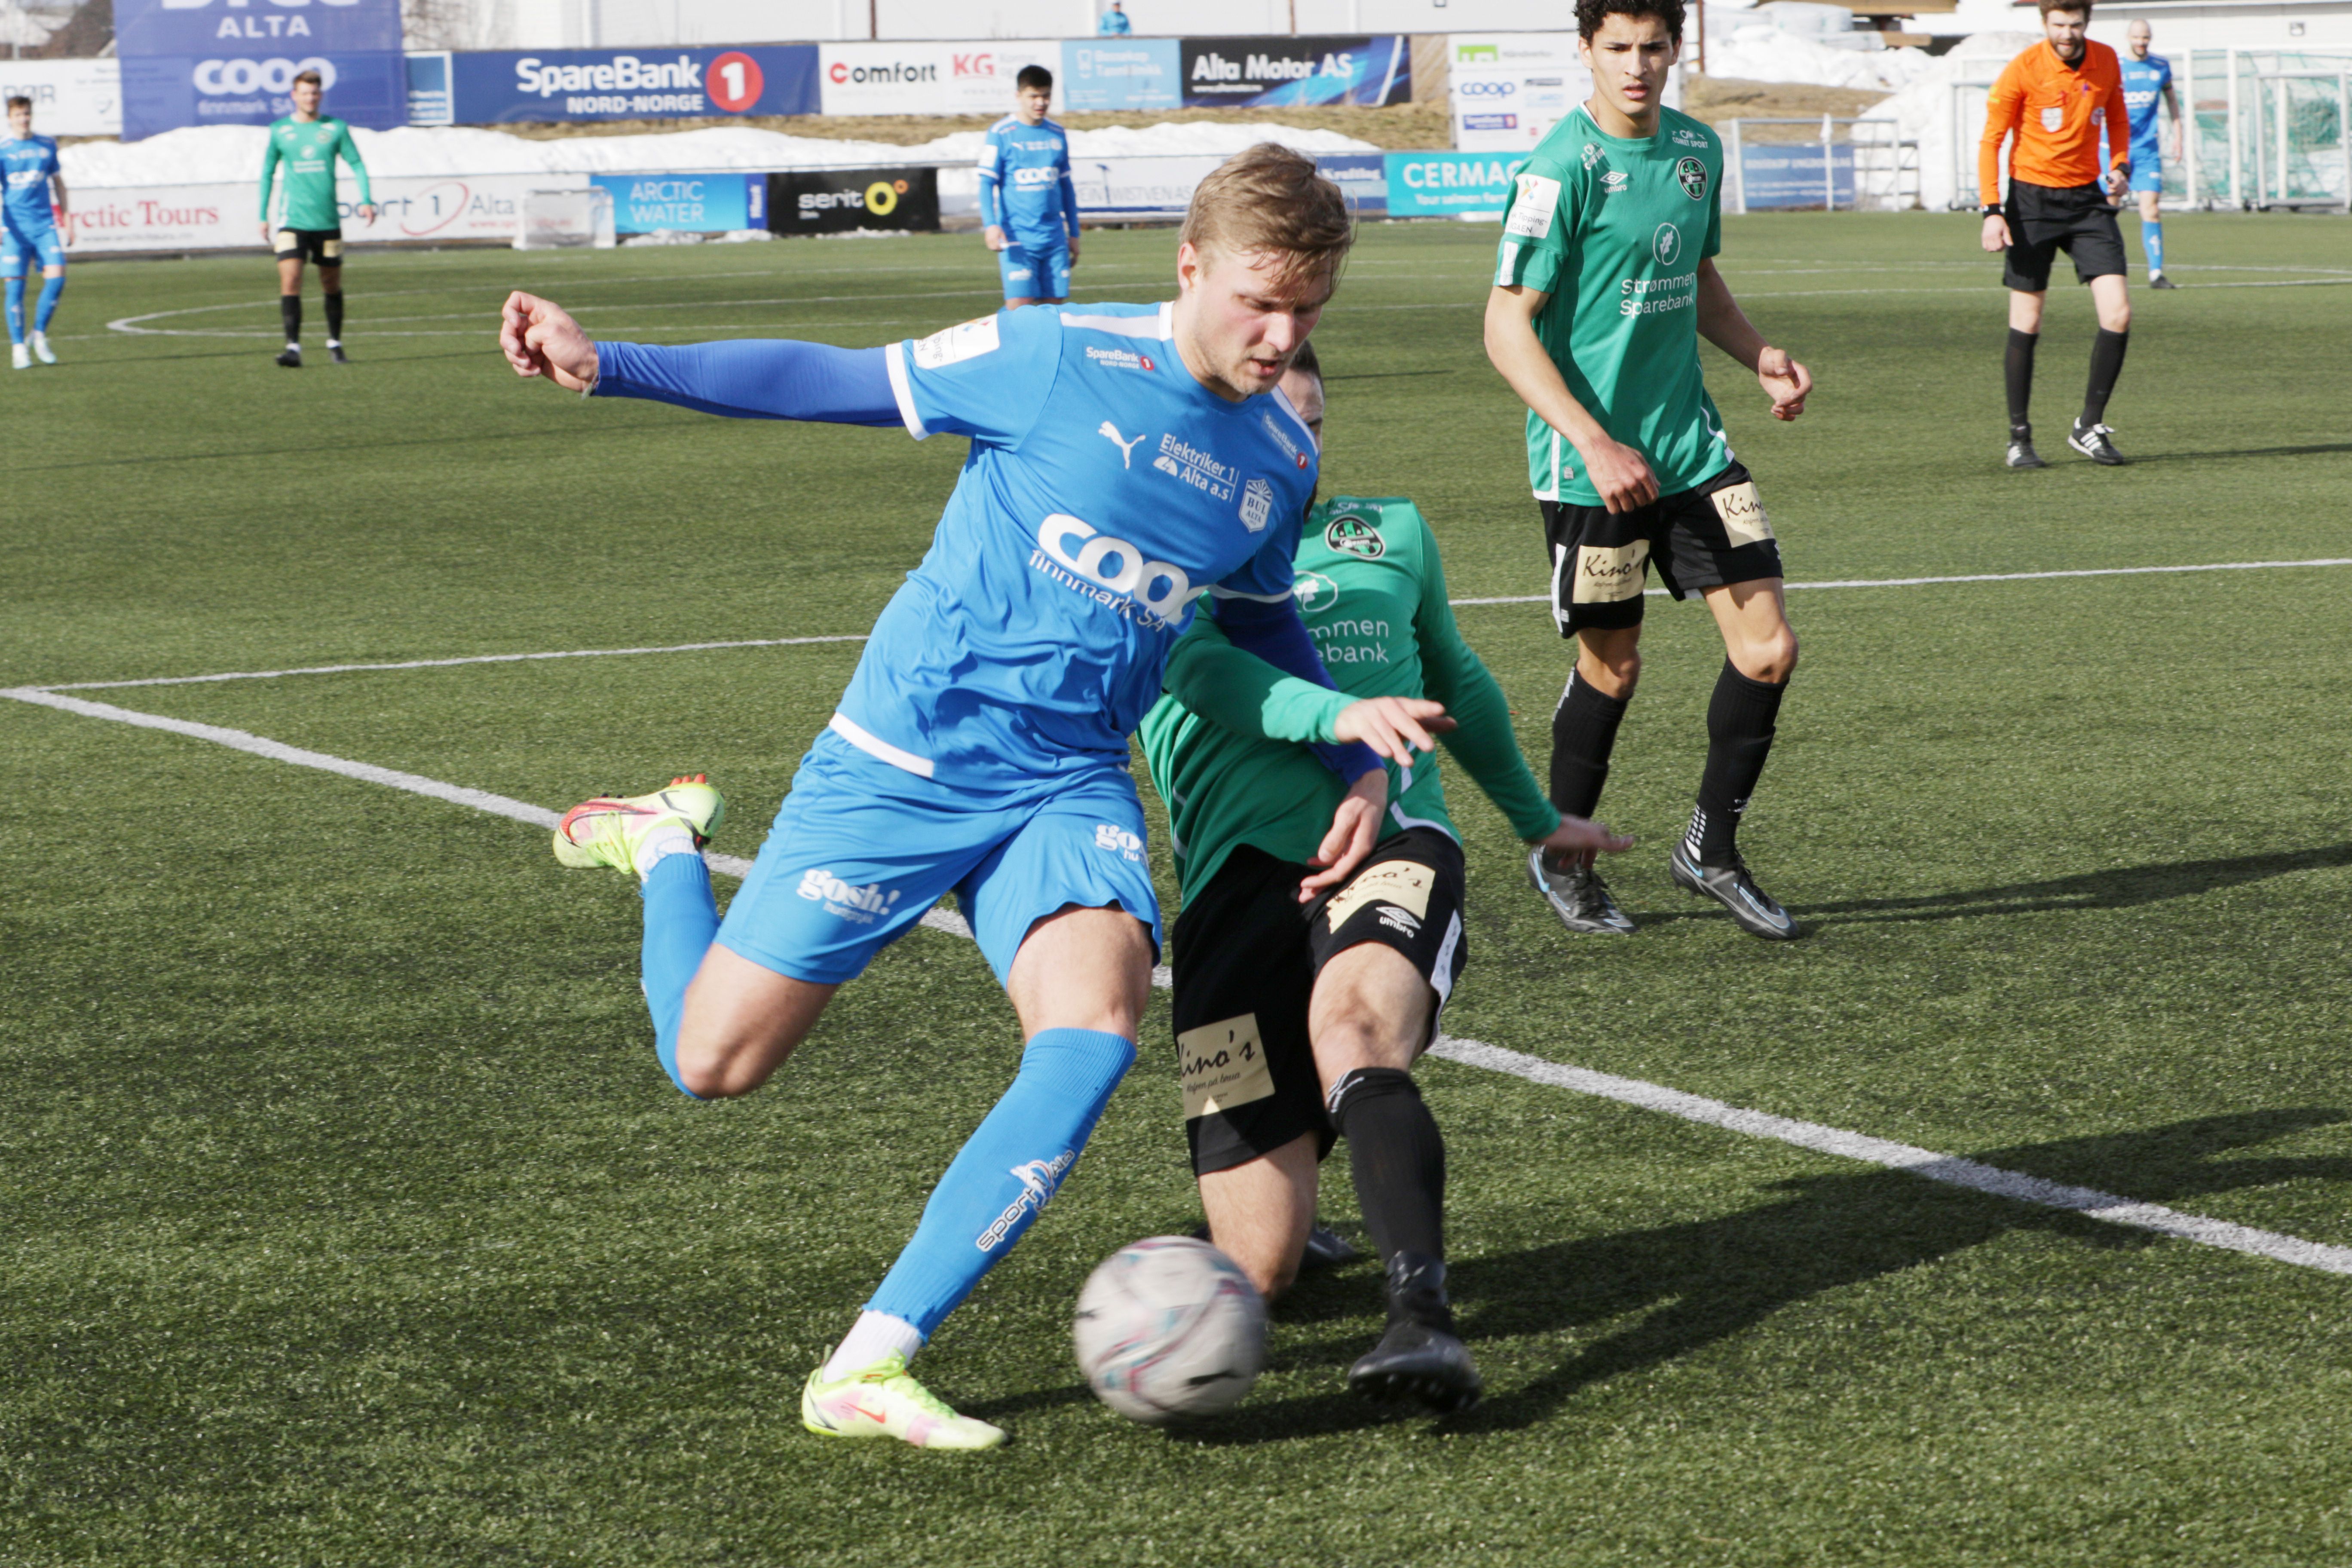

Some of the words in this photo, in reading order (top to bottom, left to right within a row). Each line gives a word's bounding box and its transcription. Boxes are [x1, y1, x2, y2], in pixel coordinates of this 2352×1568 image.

[217, 15, 310, 38] ALTA
[952, 54, 994, 76] KG
[1191, 53, 1240, 80] Alta
[1245, 54, 1314, 80] Motor
[1320, 53, 1353, 78] AS
[516, 55, 701, 97] SpareBank
[721, 62, 744, 101] 1
[1461, 82, 1516, 98] coop
[567, 94, 704, 113] NORD-NORGE
[630, 181, 704, 202] ARCTIC
[1605, 184, 1627, 193] umbro
[138, 200, 219, 225] Tours
[469, 193, 514, 214] Alta
[630, 203, 704, 222] WATER
[1621, 272, 1695, 294] Strømmen
[1620, 290, 1694, 319] Sparebank
[1086, 346, 1138, 362] SpareBank
[1143, 358, 1150, 368] 1
[1100, 360, 1139, 369] NORD-NORGE
[1161, 433, 1225, 476] Elektriker
[1228, 466, 1235, 481] 1
[1179, 467, 1208, 491] Alta
[1210, 482, 1229, 501] a.s
[1247, 497, 1265, 515] BUL
[1029, 549, 1137, 619] finnmark
[1095, 824, 1144, 852] go
[1379, 916, 1414, 943] umbro
[1180, 1030, 1256, 1078] ino's
